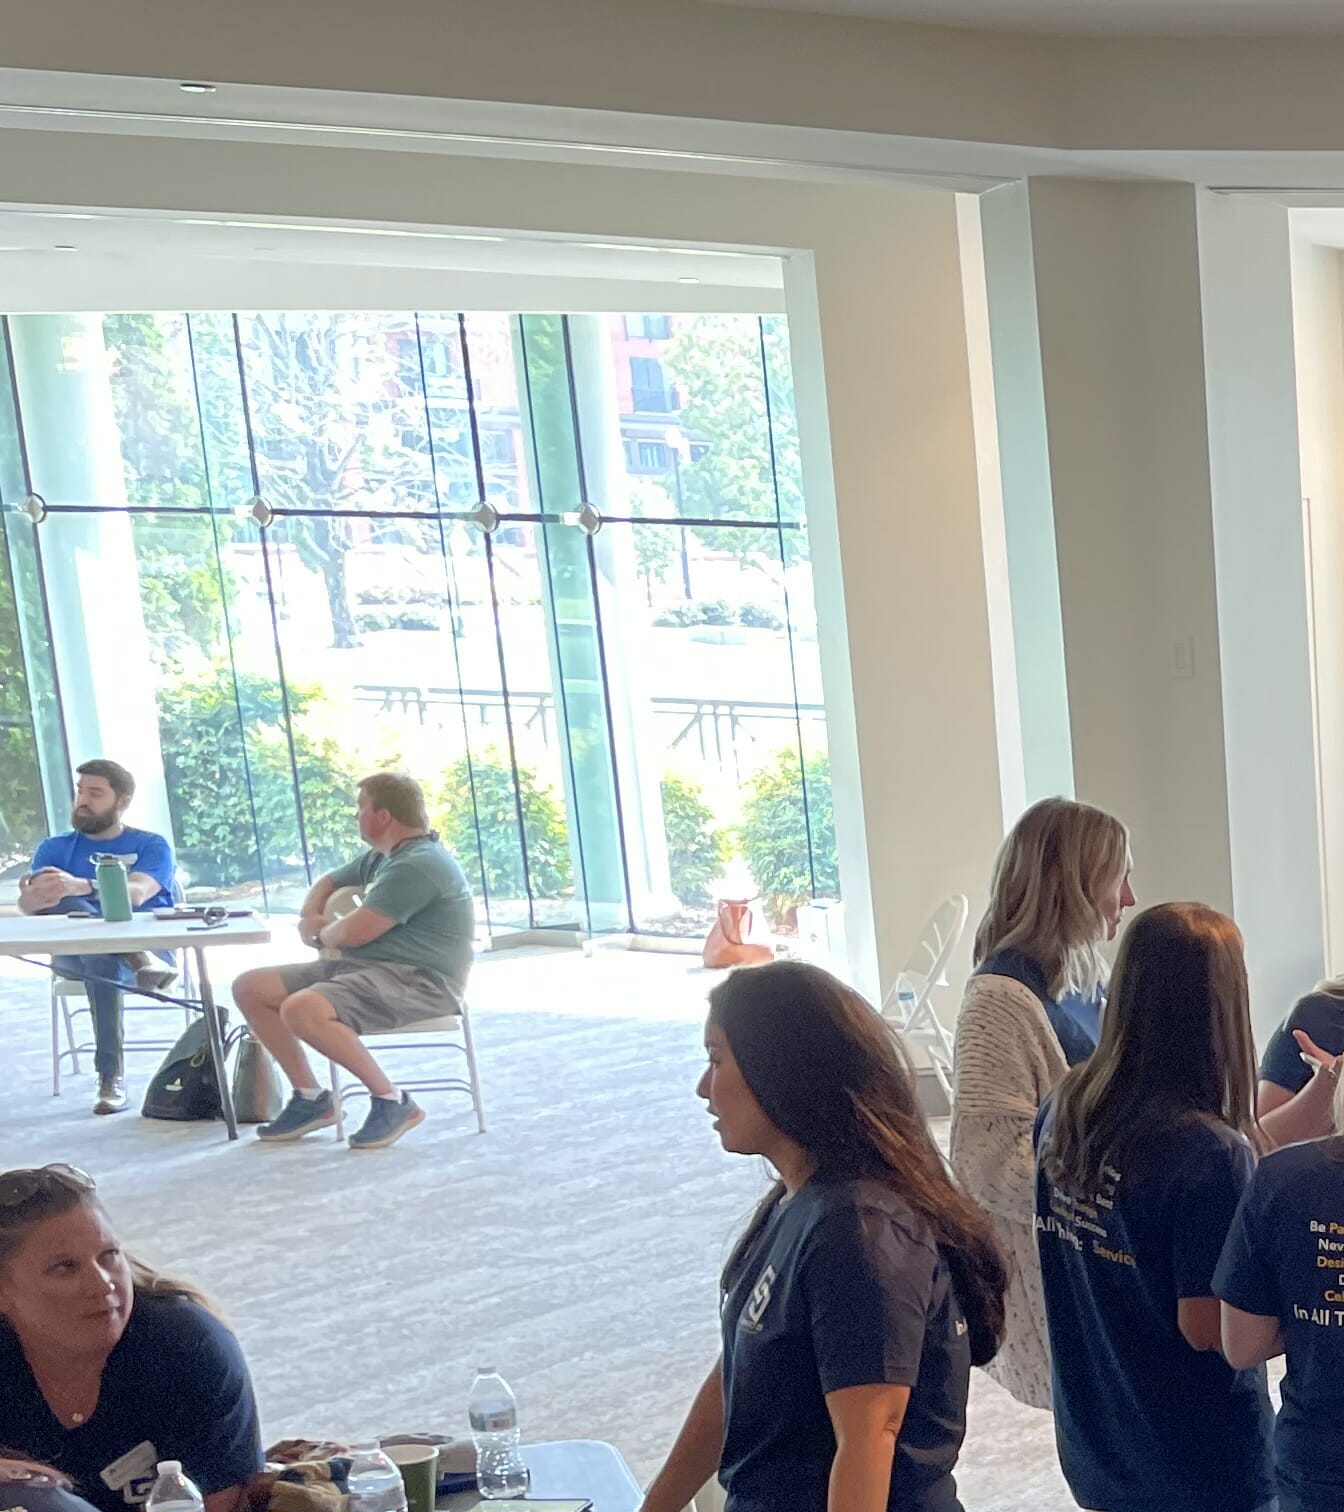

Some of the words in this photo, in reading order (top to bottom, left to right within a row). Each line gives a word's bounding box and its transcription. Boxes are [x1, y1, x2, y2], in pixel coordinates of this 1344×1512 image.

[1309, 1220, 1326, 1233] Be
[1293, 1303, 1309, 1320] In
[1311, 1309, 1330, 1326] All
